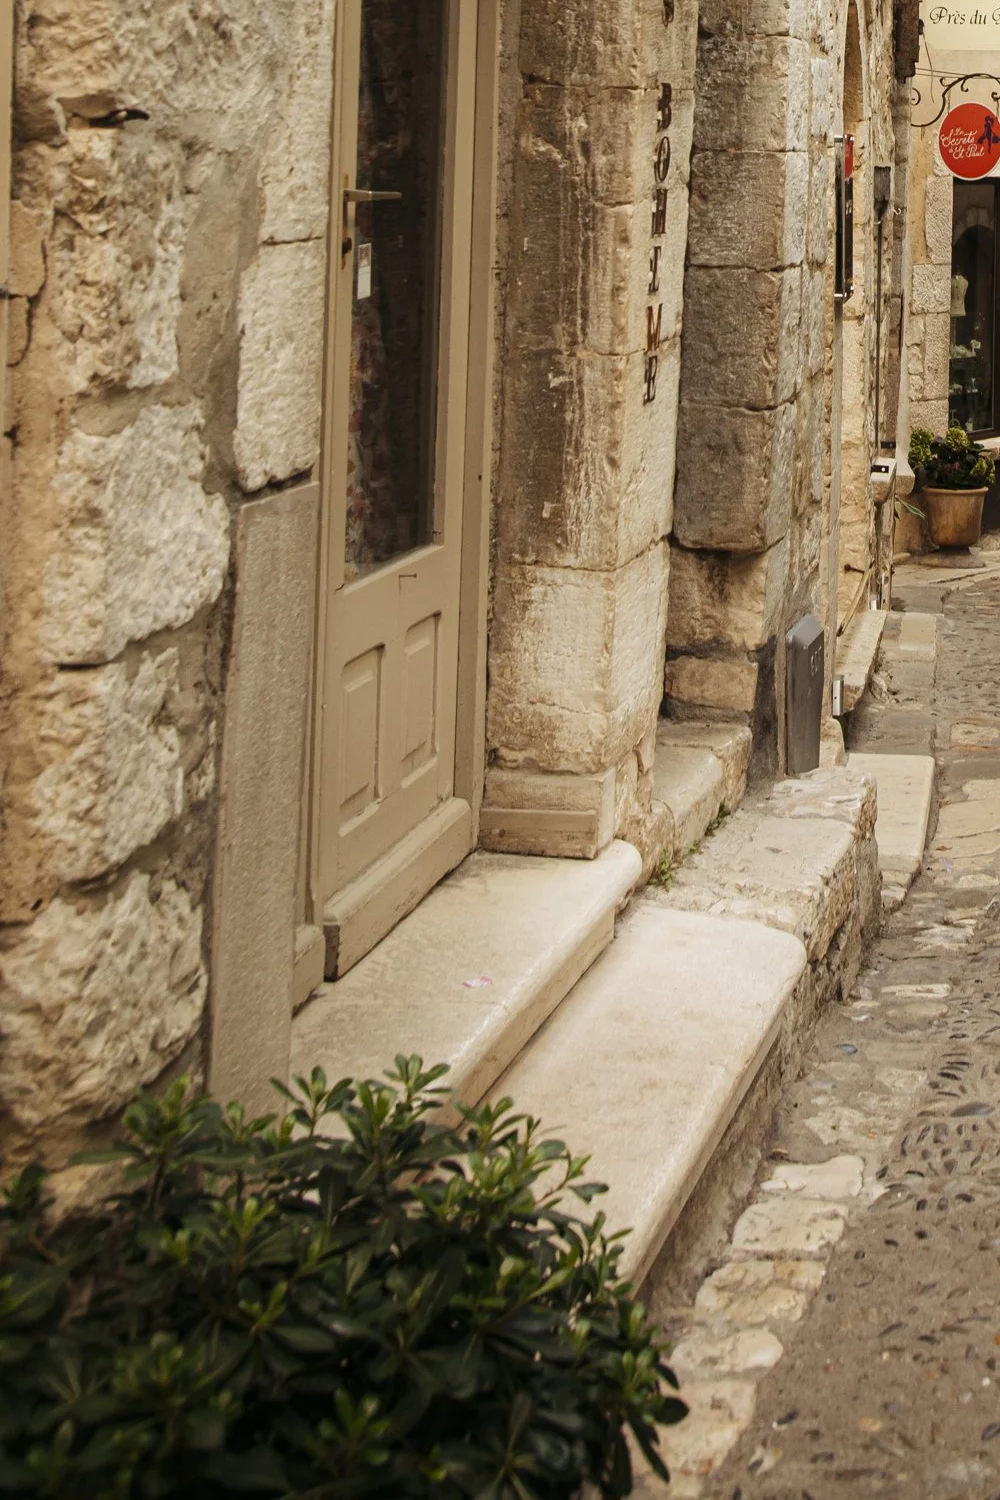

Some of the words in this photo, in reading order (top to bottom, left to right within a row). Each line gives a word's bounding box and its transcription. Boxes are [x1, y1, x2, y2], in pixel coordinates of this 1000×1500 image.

[929, 6, 966, 25] Près
[970, 9, 987, 25] du
[940, 129, 978, 147] Secrets
[966, 144, 985, 157] Paul
